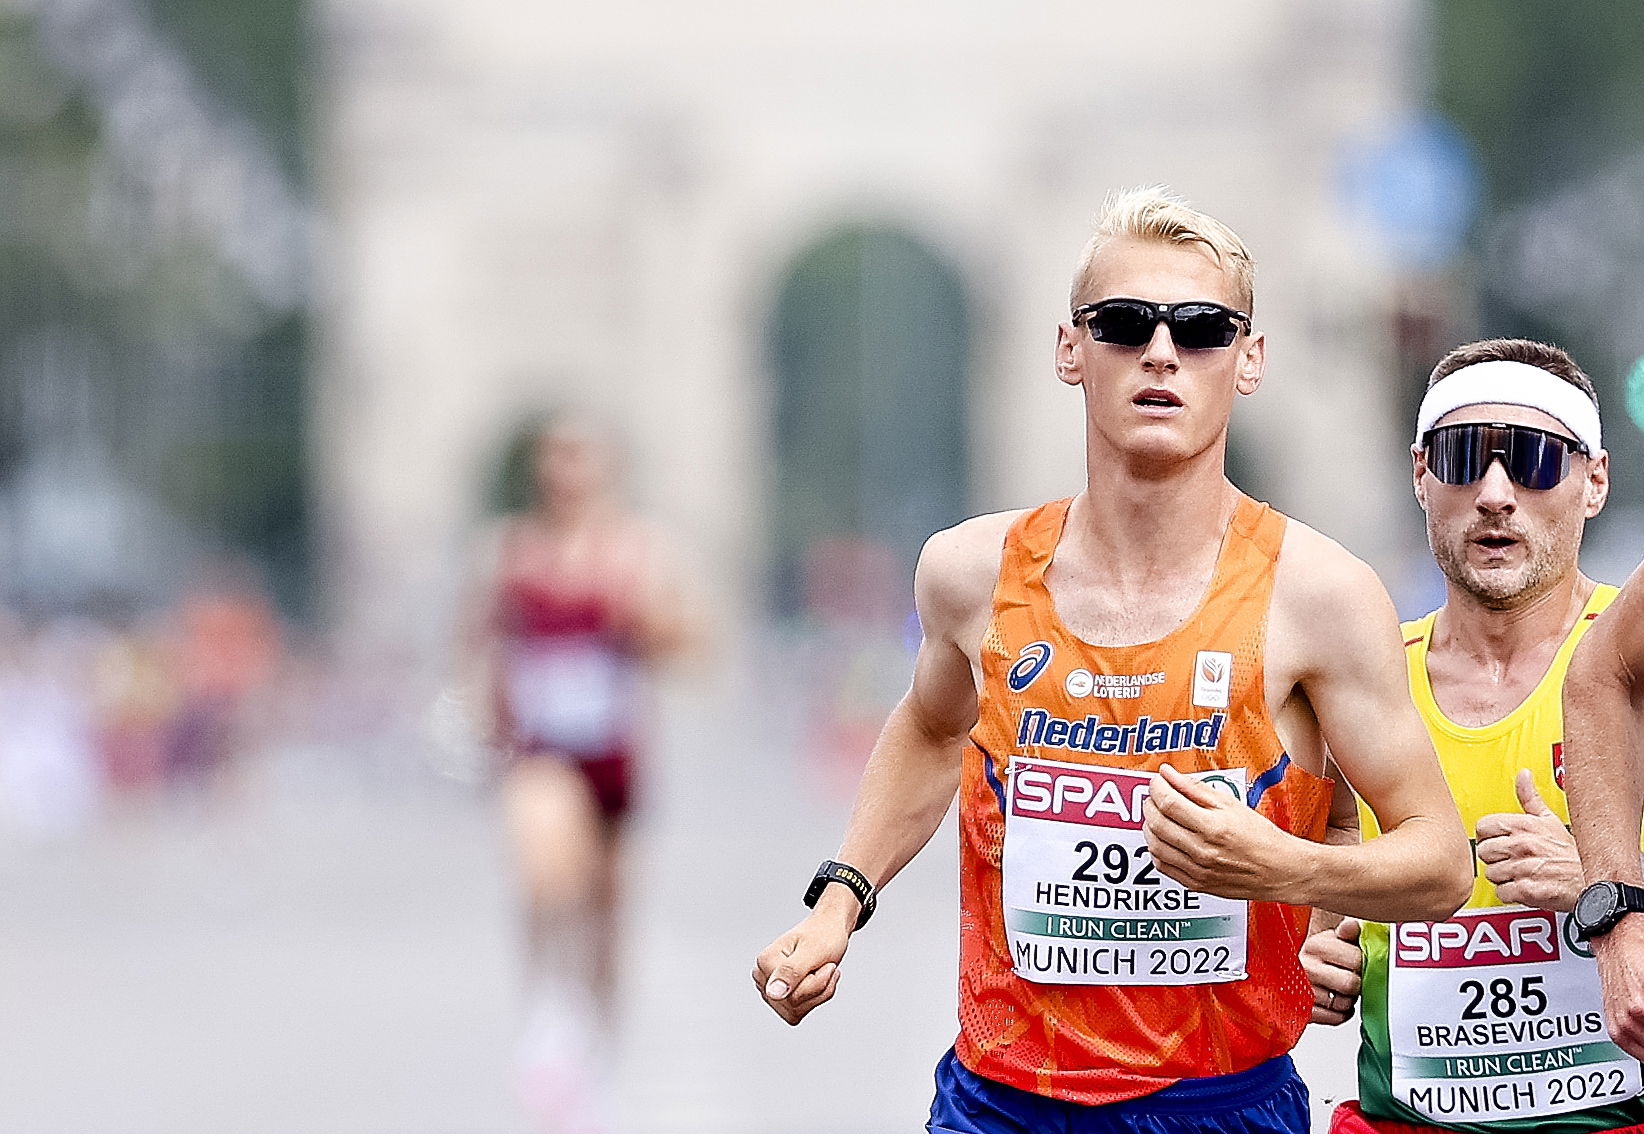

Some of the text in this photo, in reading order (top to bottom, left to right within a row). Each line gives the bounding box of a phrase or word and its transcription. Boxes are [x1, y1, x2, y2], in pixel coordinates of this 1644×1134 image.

[1093, 672, 1166, 687] NEDERLANDSE
[1093, 686, 1142, 699] LOTERIJ
[1017, 708, 1226, 755] Nederland
[1072, 840, 1161, 885] 292
[1036, 882, 1200, 911] HENDRIKSE
[1047, 917, 1053, 934] I
[1059, 917, 1104, 937] RUN
[1398, 917, 1554, 962] SPAR
[1016, 940, 1230, 975] MUNICH 2022
[1459, 975, 1548, 1020] 285
[1417, 1012, 1602, 1047] BRASEVICIUS
[1446, 1061, 1451, 1076] I
[1457, 1058, 1501, 1075] RUN
[1409, 1069, 1626, 1114] MUNICH 2022
